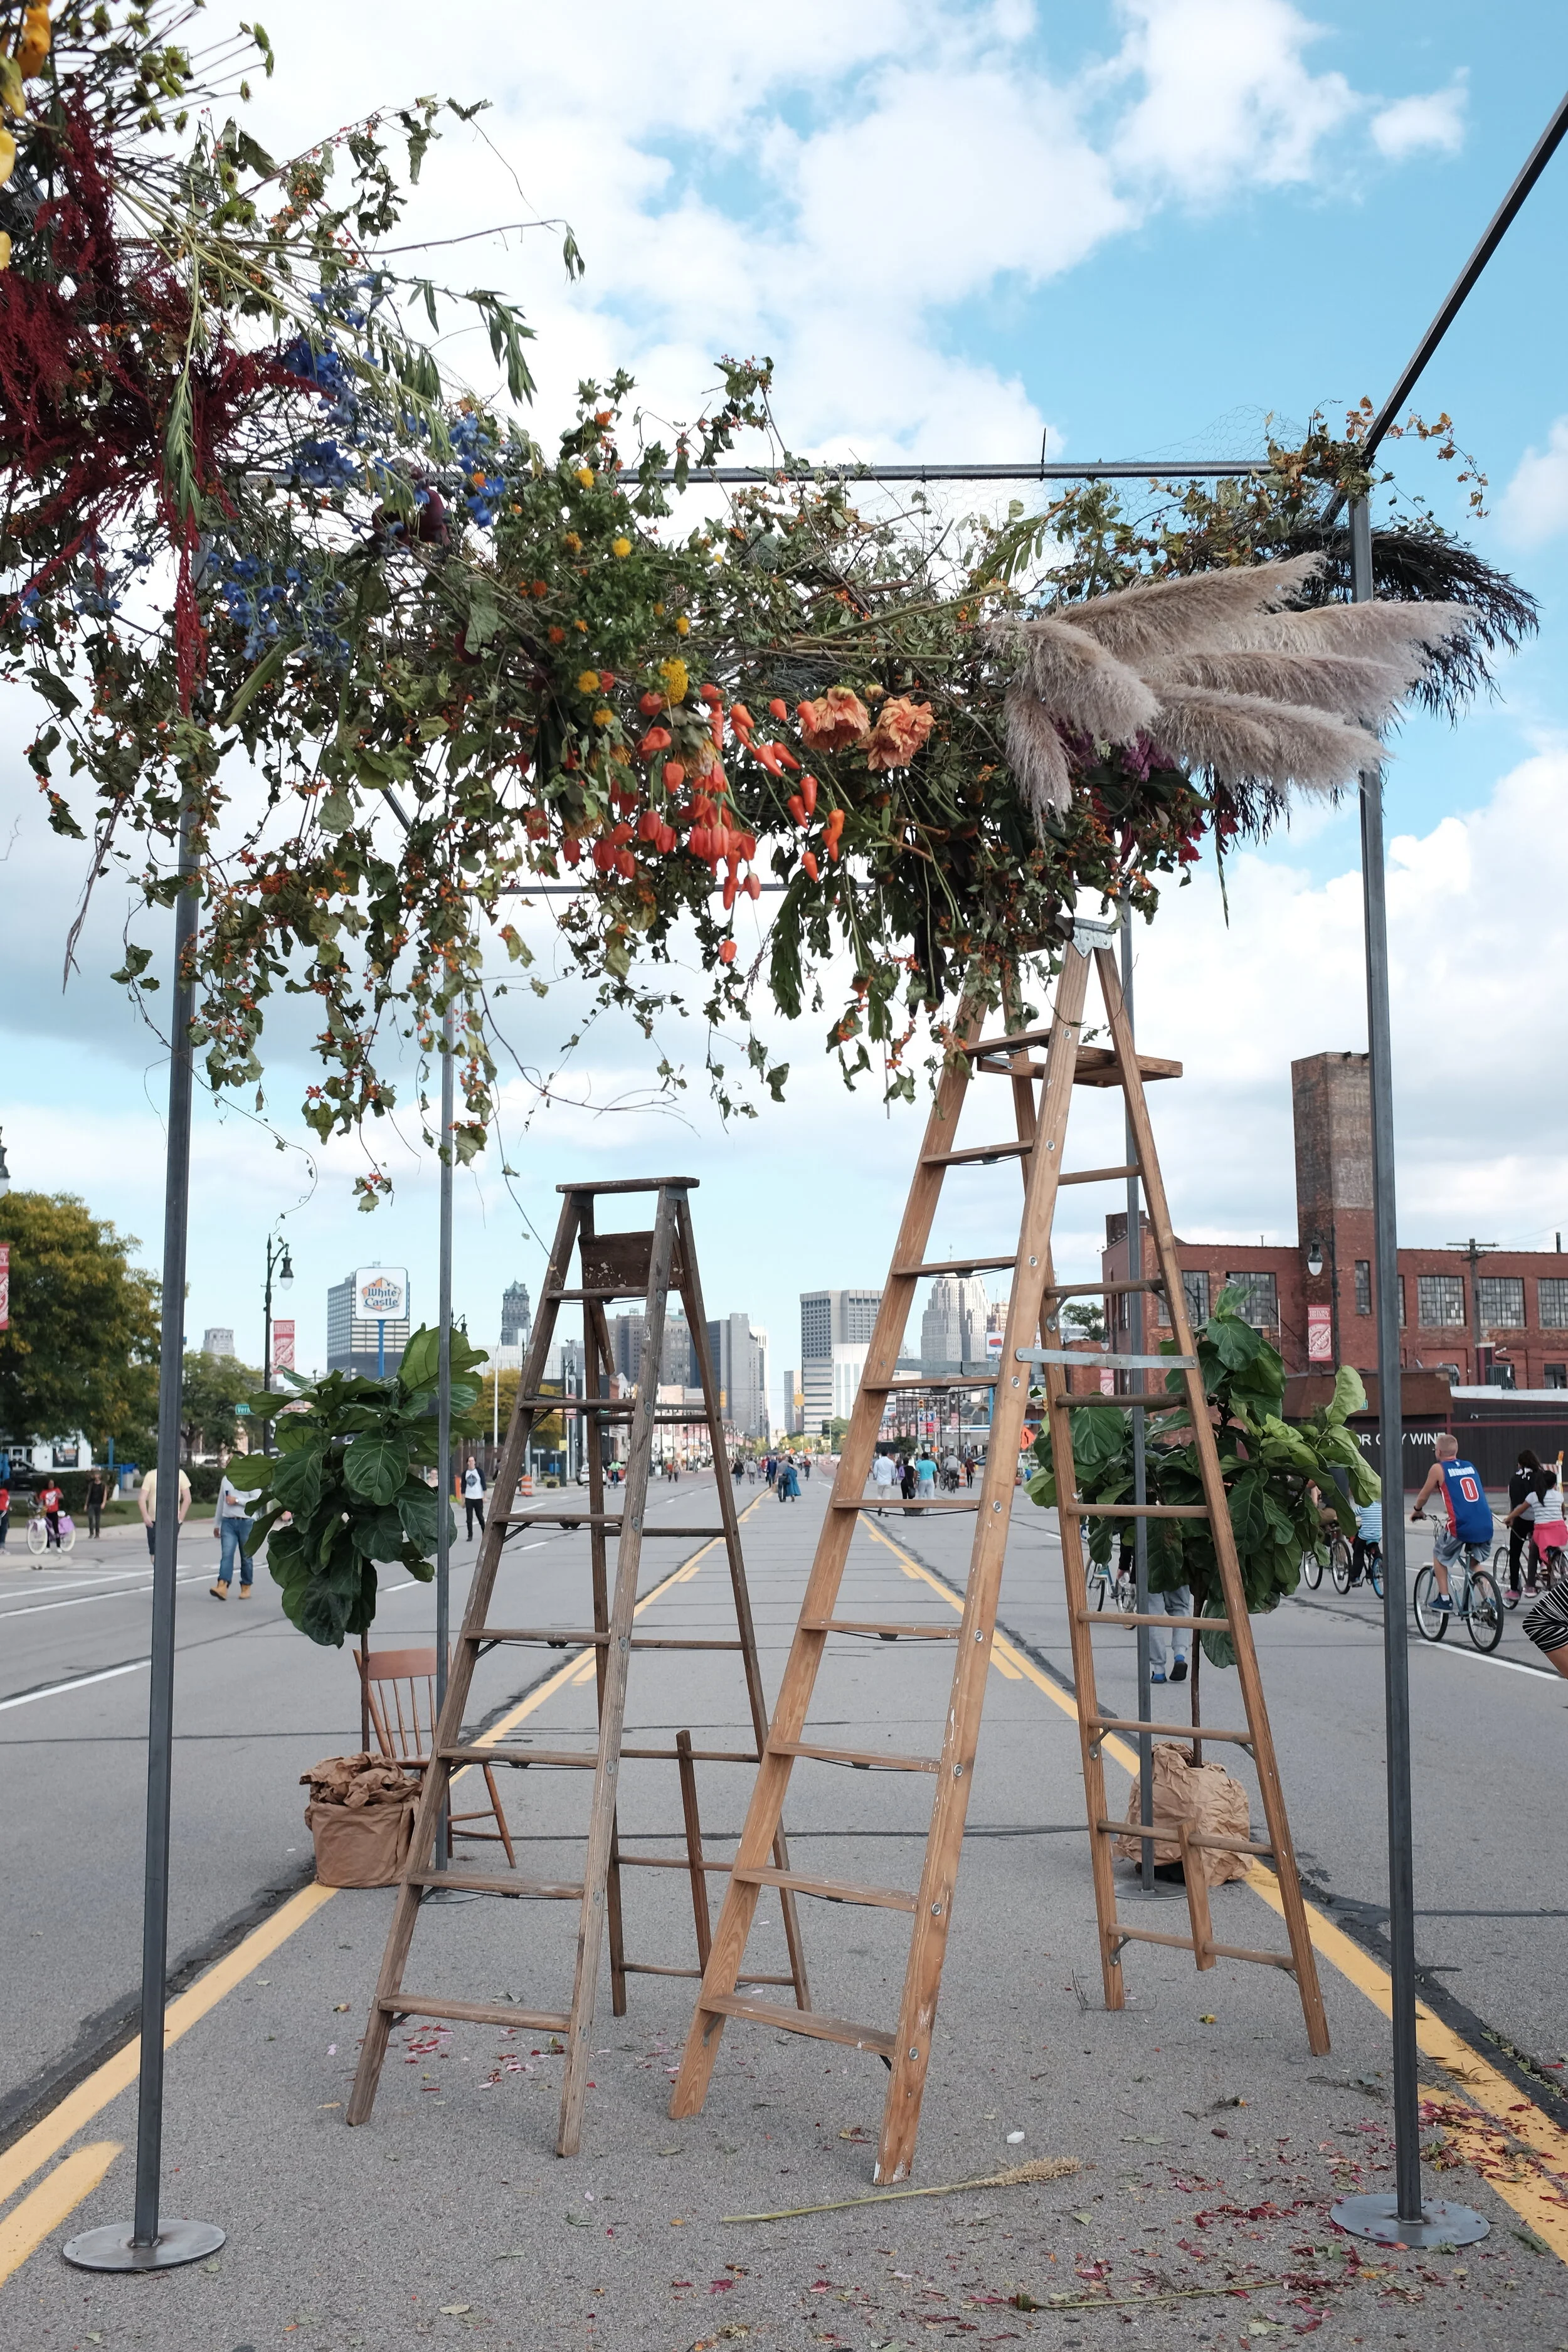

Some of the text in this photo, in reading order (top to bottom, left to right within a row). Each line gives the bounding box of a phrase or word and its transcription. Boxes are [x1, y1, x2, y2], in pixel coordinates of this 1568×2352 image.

[368, 1288, 396, 1298] White
[364, 1298, 398, 1306] Castle
[1410, 1432, 1446, 1445] WIN
[1459, 1476, 1480, 1503] 0
